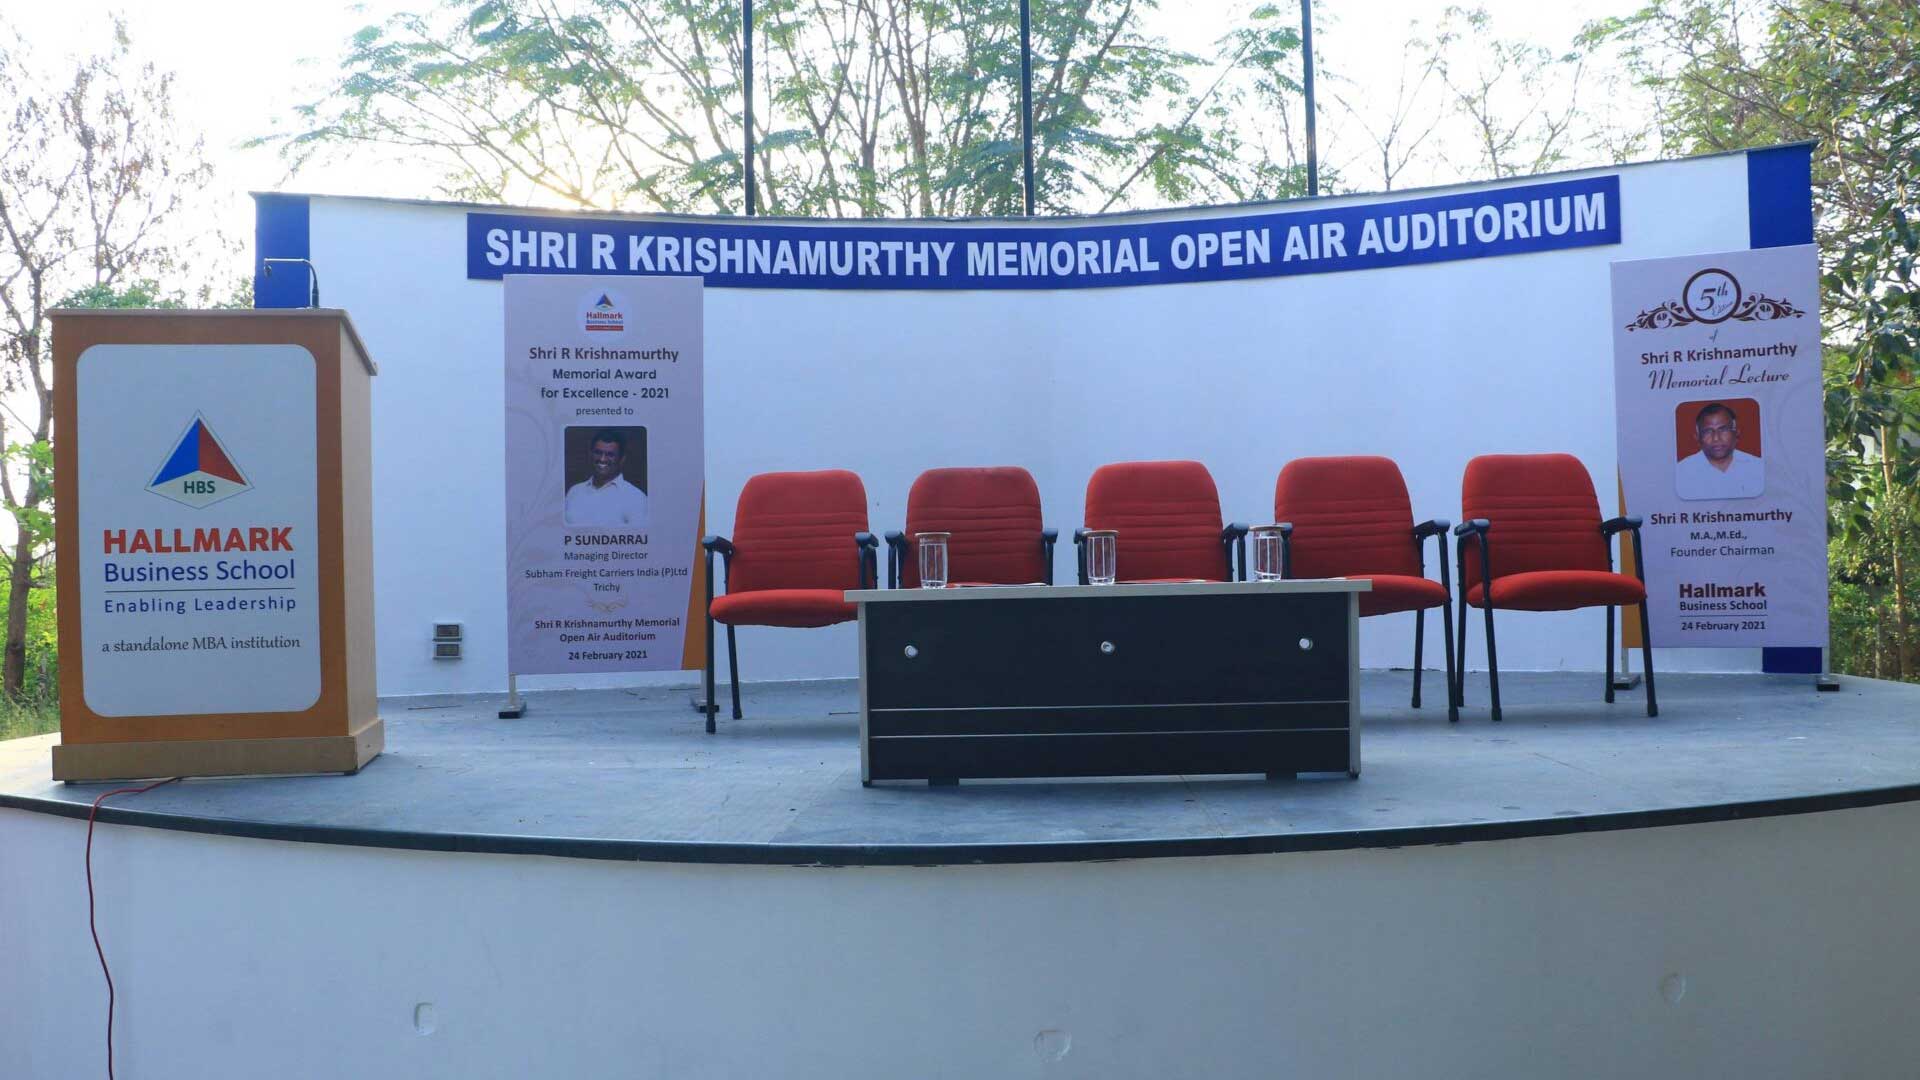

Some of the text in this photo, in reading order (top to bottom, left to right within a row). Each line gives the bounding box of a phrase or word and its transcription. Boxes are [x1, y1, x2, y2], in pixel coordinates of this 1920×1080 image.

[486, 192, 1606, 277] SHRI R KRISHNAMURTHY MEMORIAL OPEN AIR AUDITORIUM
[1695, 280, 1728, 311] 5th
[529, 347, 678, 363] Shri R Krishnamurthy
[1641, 342, 1797, 365] Shri R Krishnamurthy
[553, 369, 656, 379] Memorial Award
[1649, 364, 1789, 390] Memorial Lecture
[541, 388, 559, 398] for
[563, 388, 628, 398] Excellence
[641, 388, 669, 398] 2021
[576, 407, 633, 416] presented to
[183, 481, 215, 494] HBS
[1651, 509, 1792, 524] Shri R Krishnamurthy
[104, 527, 293, 553] HALLMARK
[564, 535, 648, 545] P SUNDARRAJ
[564, 552, 609, 561] Managing
[1671, 546, 1775, 557] Founder Chairman
[105, 559, 295, 582] Business School
[526, 570, 562, 578] Subham
[565, 569, 597, 579] Freight
[600, 569, 634, 577] Carriers
[637, 568, 659, 576] India
[594, 583, 620, 592] Trichy
[1680, 583, 1766, 598] Hallmark
[105, 596, 296, 614] Enabling Leadership
[1680, 600, 1767, 611] Business School
[535, 618, 680, 629] Shri R Krishnamurthy Memorial
[1681, 621, 1765, 632] 24 February 2021
[560, 632, 655, 643] Open Air Auditorium
[102, 636, 300, 653] a standalone MBA institution
[568, 650, 647, 661] 24 February 2021
